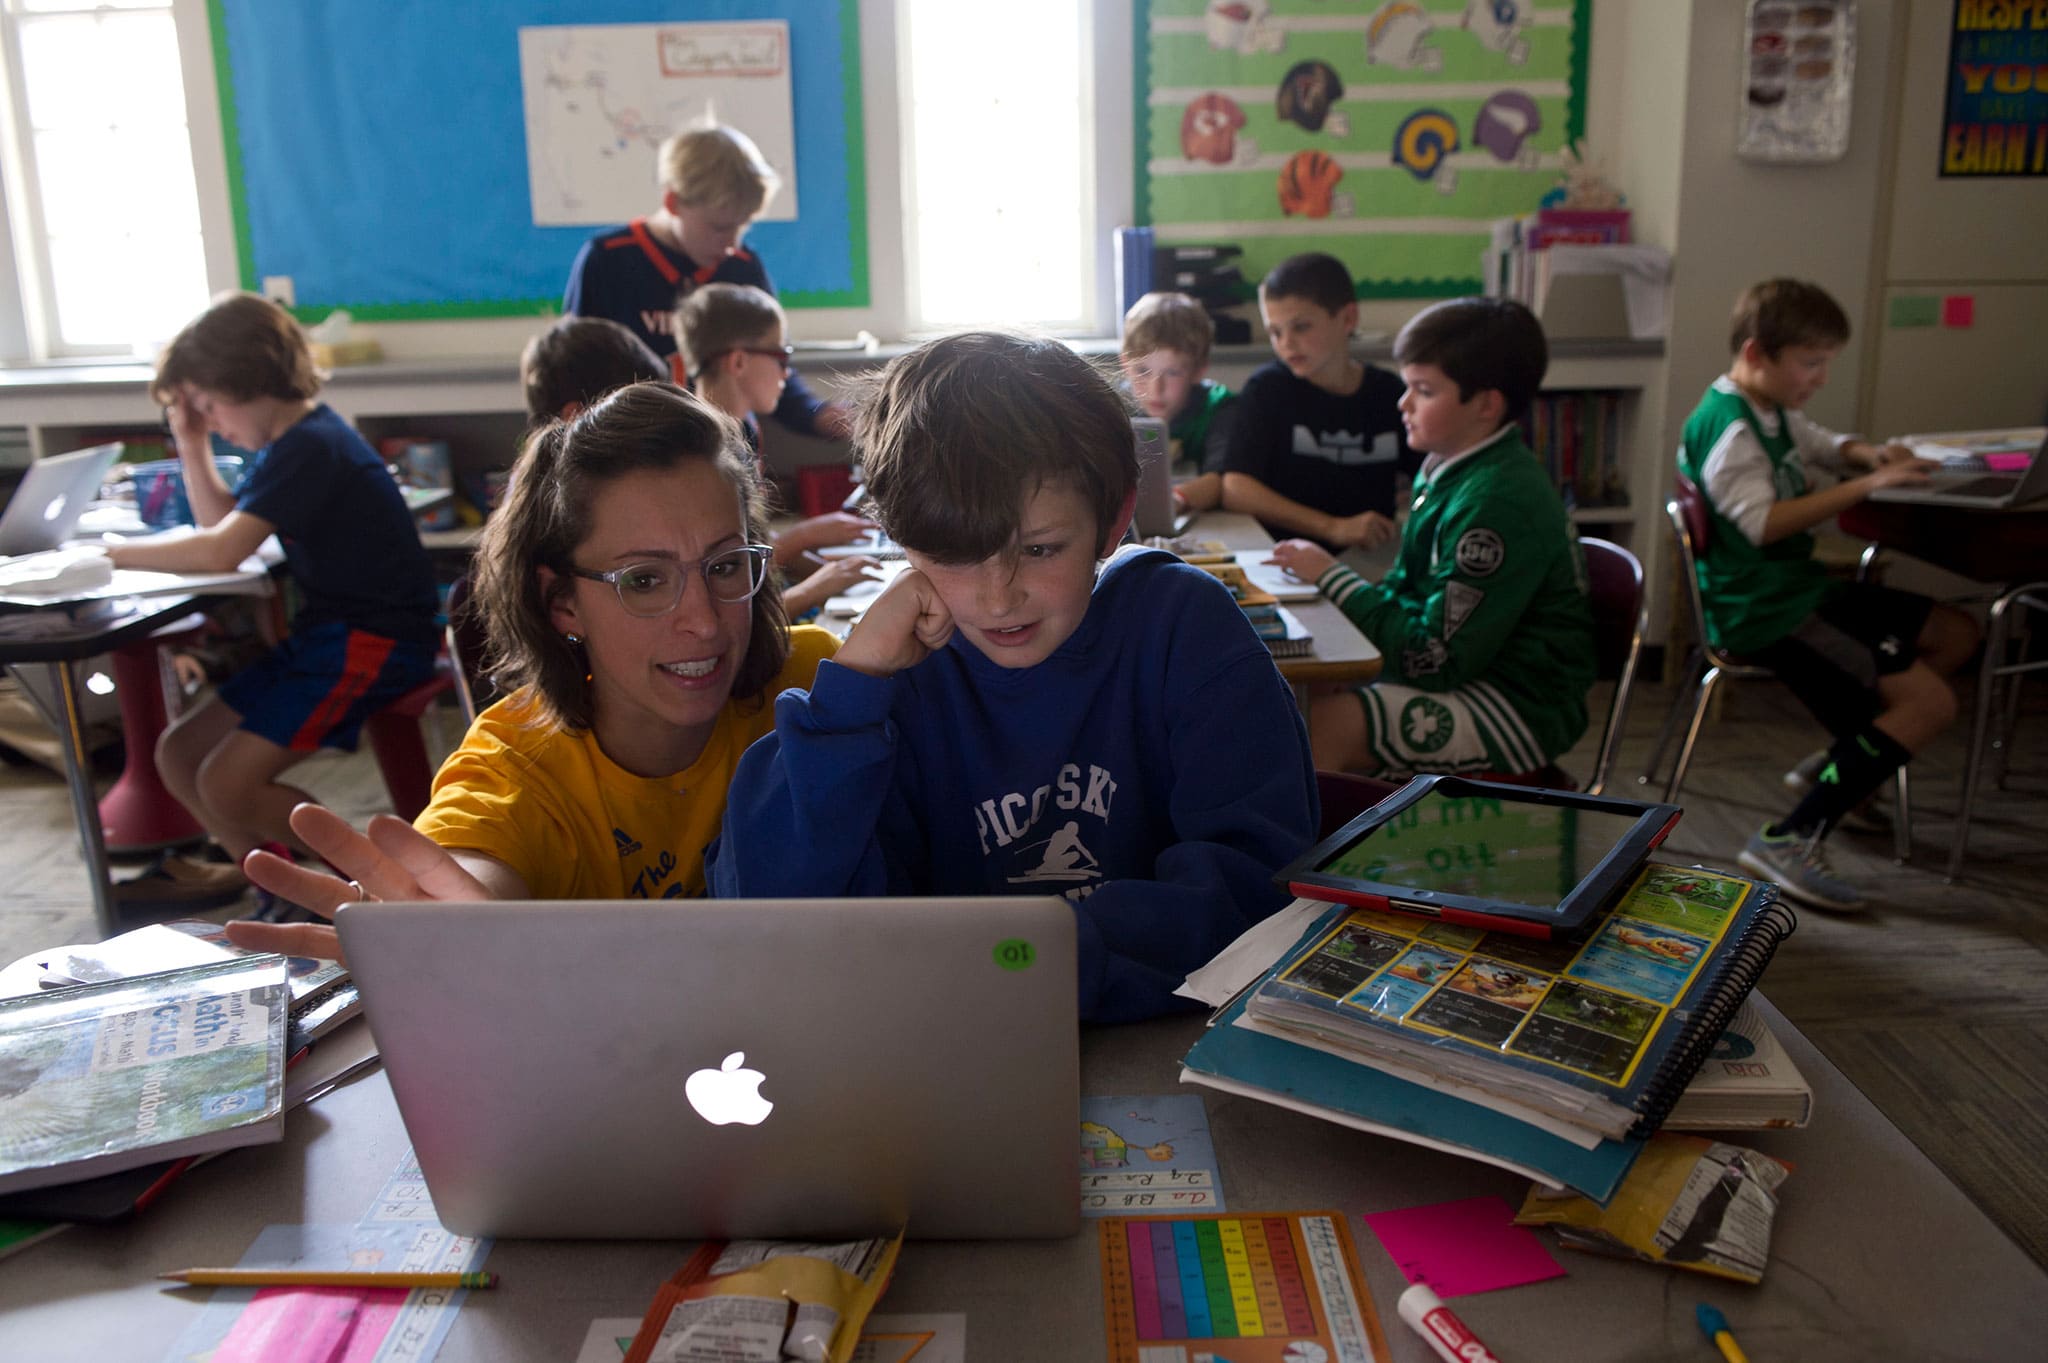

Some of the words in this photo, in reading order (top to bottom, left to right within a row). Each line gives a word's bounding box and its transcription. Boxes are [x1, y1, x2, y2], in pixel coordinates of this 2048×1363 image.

[1956, 0, 2048, 31] RESPE
[973, 784, 1052, 856] PICO
[632, 850, 677, 898] The
[136, 1071, 168, 1139] Workbook
